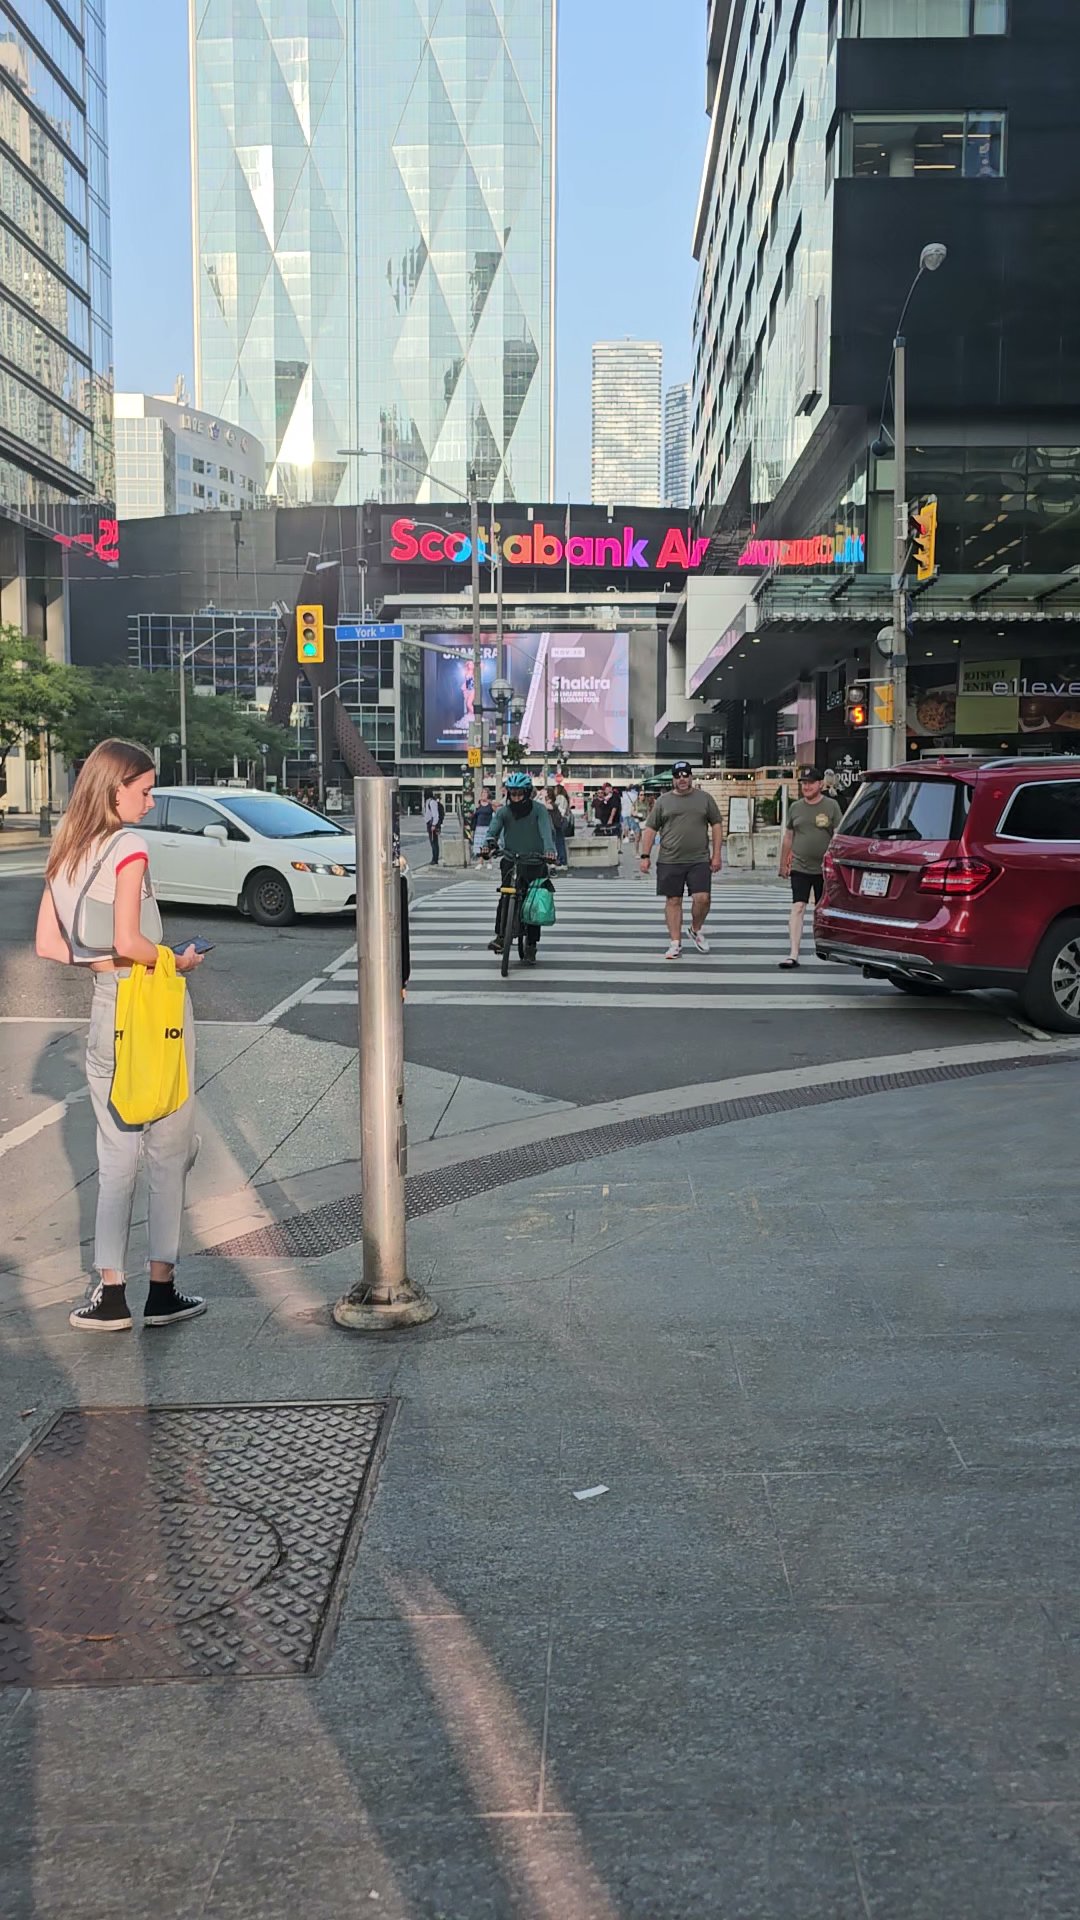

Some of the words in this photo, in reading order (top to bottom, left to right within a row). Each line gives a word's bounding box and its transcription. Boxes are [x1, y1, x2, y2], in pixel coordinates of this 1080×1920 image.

[391, 518, 648, 567] Scotiabank
[355, 627, 377, 637] York
[551, 676, 610, 690] Shakira
[854, 707, 863, 723] 5
